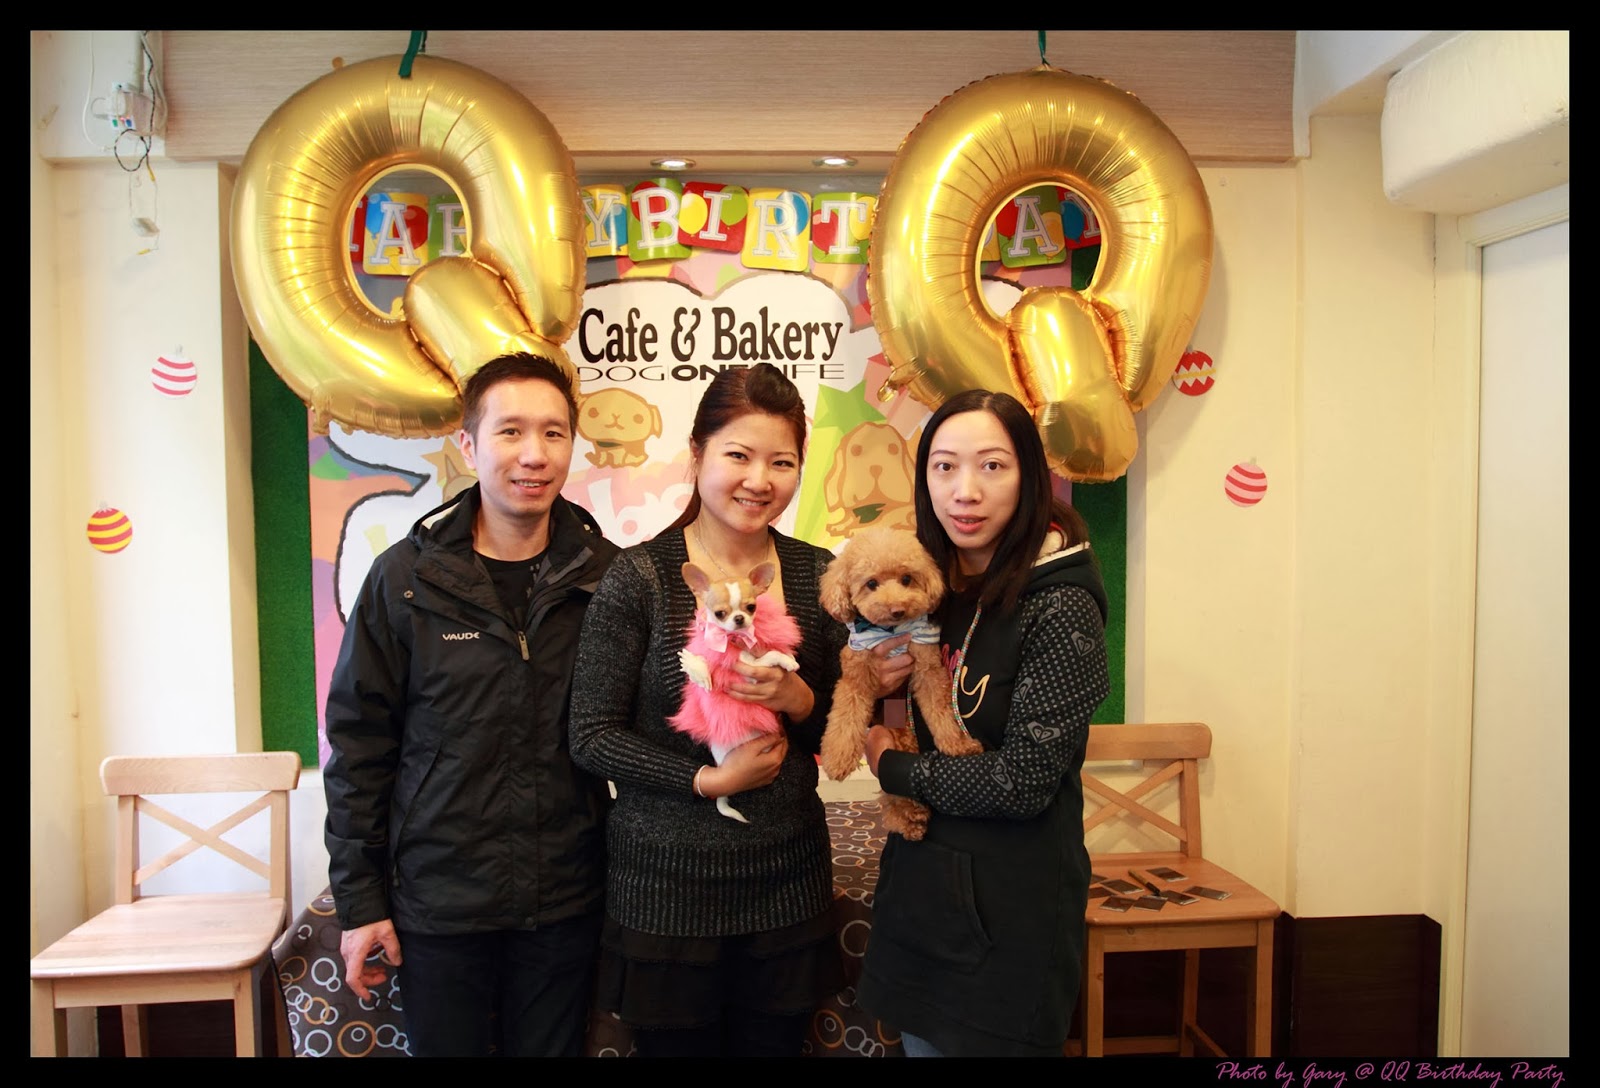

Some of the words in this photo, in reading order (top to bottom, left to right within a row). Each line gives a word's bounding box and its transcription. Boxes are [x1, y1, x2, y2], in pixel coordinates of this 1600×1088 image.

[578, 307, 658, 363] Cafe
[671, 306, 701, 362] &
[711, 306, 844, 362] Bakery
[578, 365, 664, 382] DOG
[671, 364, 749, 381] ON
[783, 363, 844, 379] IFE
[442, 632, 480, 641] VAUDE
